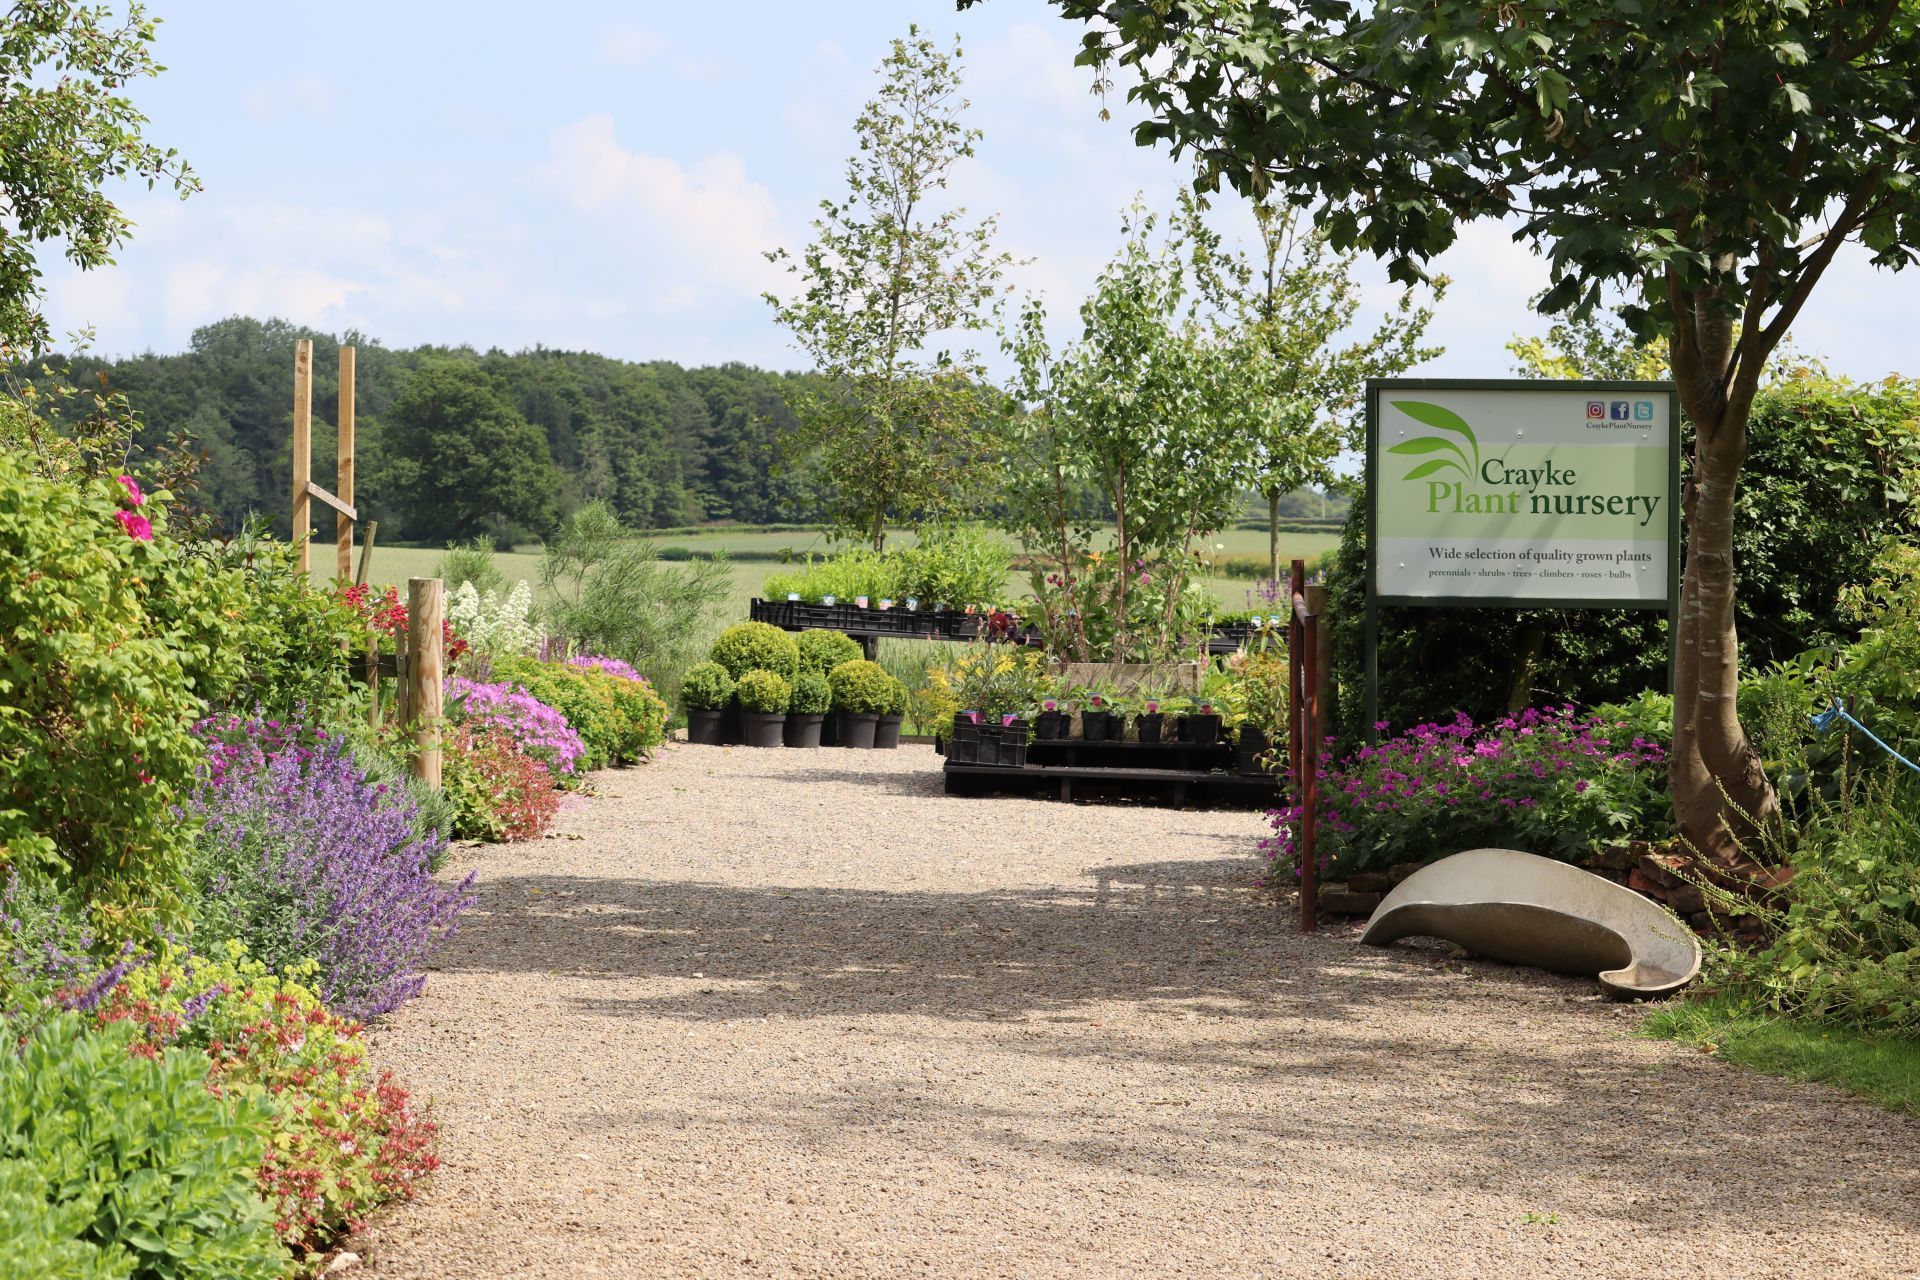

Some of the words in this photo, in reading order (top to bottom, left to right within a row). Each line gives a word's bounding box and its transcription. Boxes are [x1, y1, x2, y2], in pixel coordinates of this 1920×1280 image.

[1586, 421, 1652, 431] CraykePlantNursery
[1481, 459, 1576, 493] Crayke
[1426, 481, 1520, 514] Plant
[1530, 493, 1661, 526] nursery
[1429, 547, 1461, 559] Wide
[1465, 547, 1516, 560] selection
[1519, 548, 1532, 560] of
[1533, 549, 1573, 564] quality
[1576, 552, 1613, 564] grown
[1616, 550, 1652, 564] plants
[1429, 568, 1471, 578] perennials
[1478, 569, 1505, 577] shrubs
[1539, 569, 1574, 578] climbers
[1609, 570, 1631, 579] bulbs
